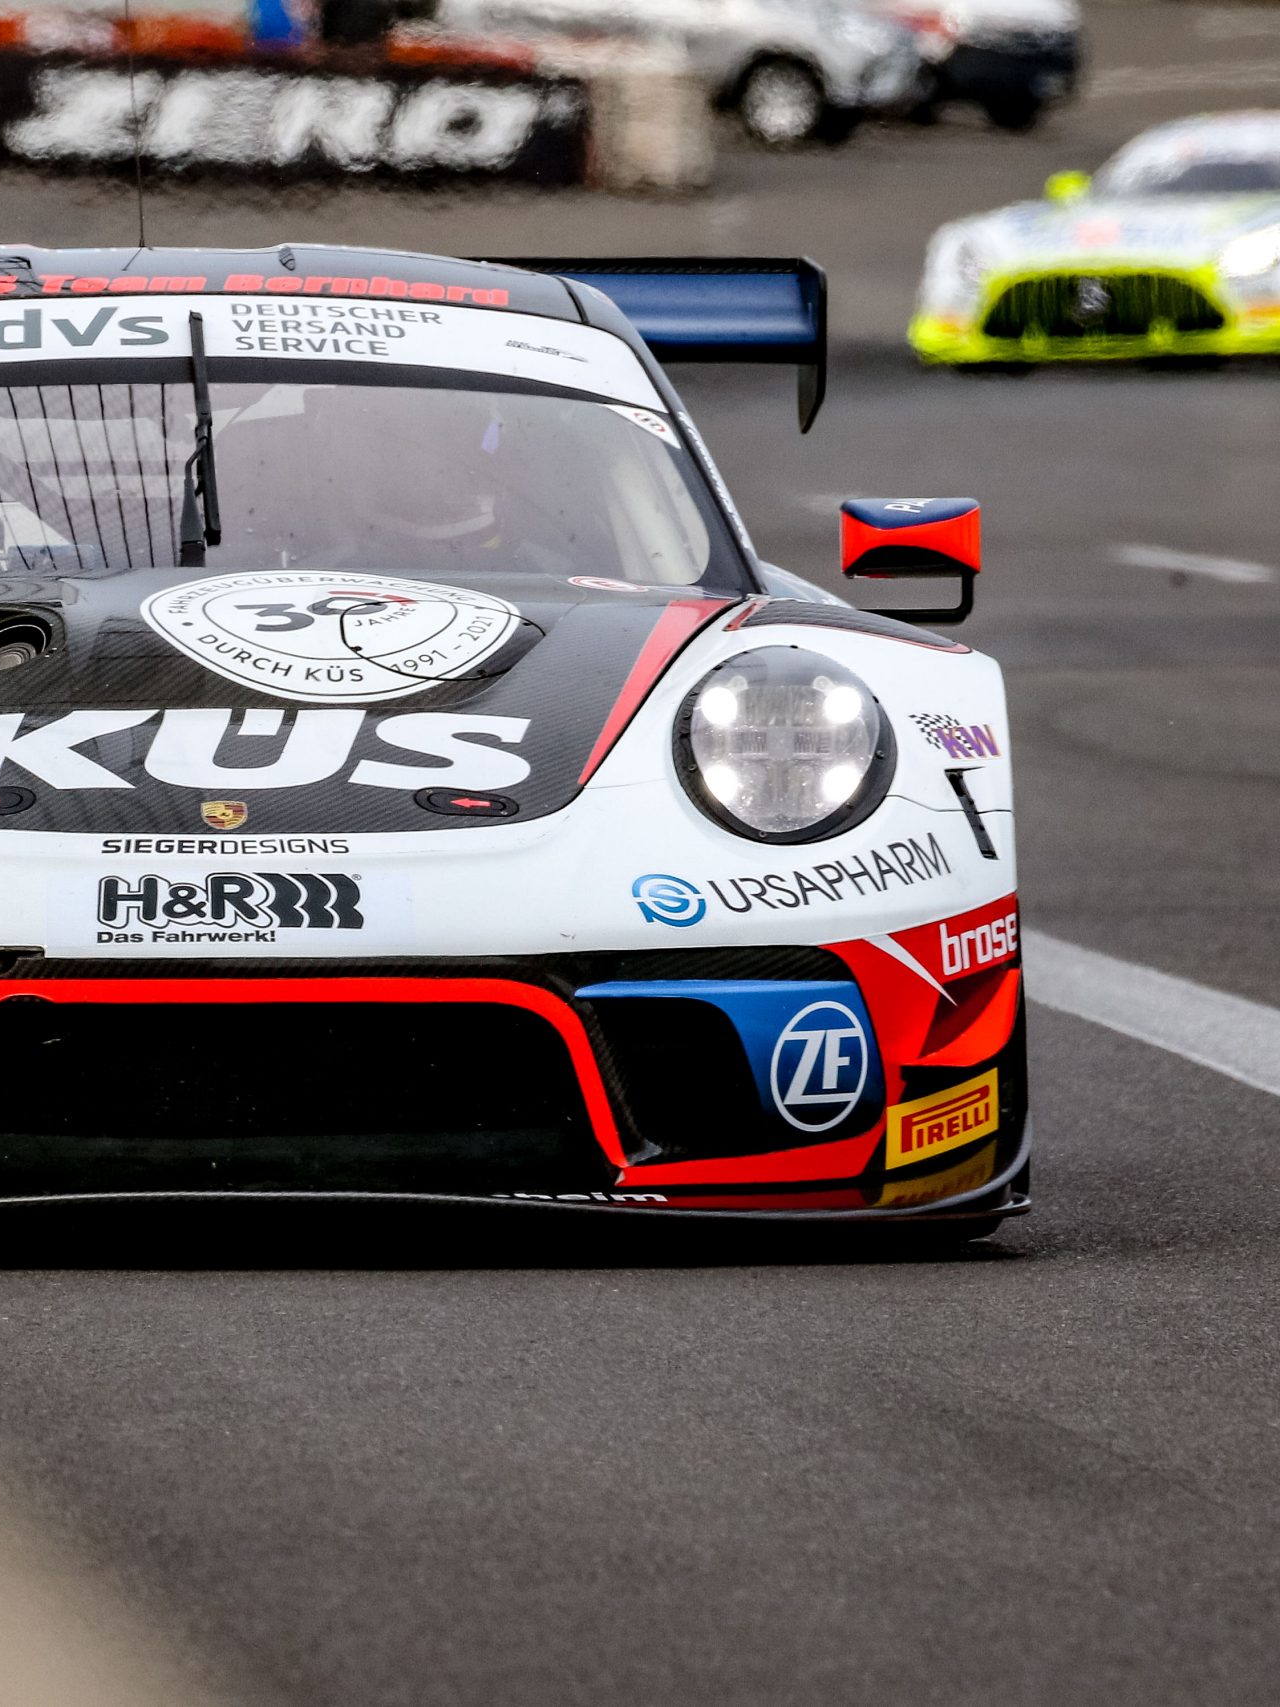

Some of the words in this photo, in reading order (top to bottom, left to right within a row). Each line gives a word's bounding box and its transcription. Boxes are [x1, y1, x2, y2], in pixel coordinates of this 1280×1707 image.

[37, 274, 207, 295] Team
[223, 274, 508, 307] Bernhard
[231, 303, 443, 325] DEUTSCHER
[233, 319, 407, 339] VERSAND
[235, 336, 391, 356] SERVICE
[167, 575, 477, 615] FAHRZEUGÜBERWACHUNG
[353, 605, 417, 628] JAHRE
[458, 615, 496, 642] 2021
[196, 633, 294, 677] DURCH
[304, 664, 364, 683] KÜS
[937, 724, 1002, 759] KW
[101, 838, 350, 855] SIEGERDESIGNS
[707, 832, 952, 915] URSAPHARM
[97, 931, 144, 944] Das
[152, 930, 276, 943] Fahrwerk!
[939, 911, 1018, 977] brose
[774, 1028, 866, 1106] ZF
[901, 1085, 990, 1154] PIRELLI
